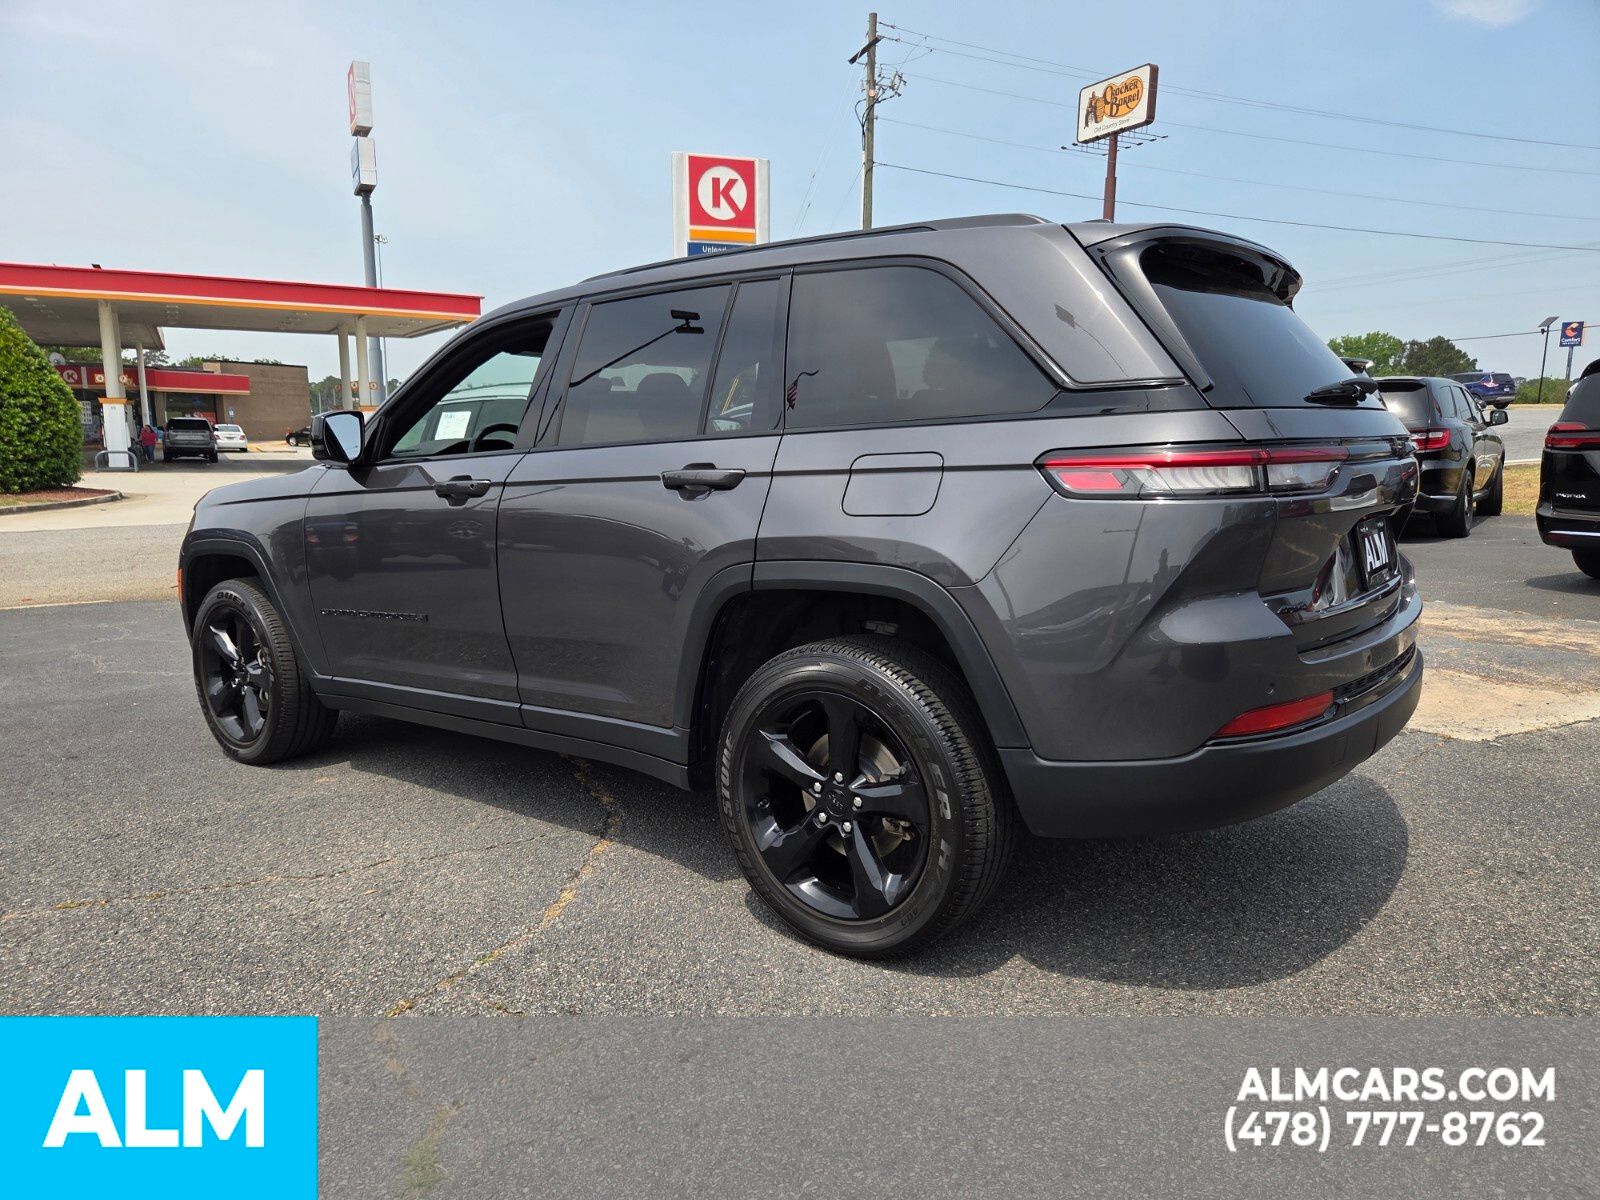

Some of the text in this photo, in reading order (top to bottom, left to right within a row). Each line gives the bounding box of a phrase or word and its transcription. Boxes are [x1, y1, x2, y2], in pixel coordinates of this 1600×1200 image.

[1110, 90, 1140, 117] Barrel
[711, 177, 742, 217] K
[1364, 531, 1389, 572] ALM
